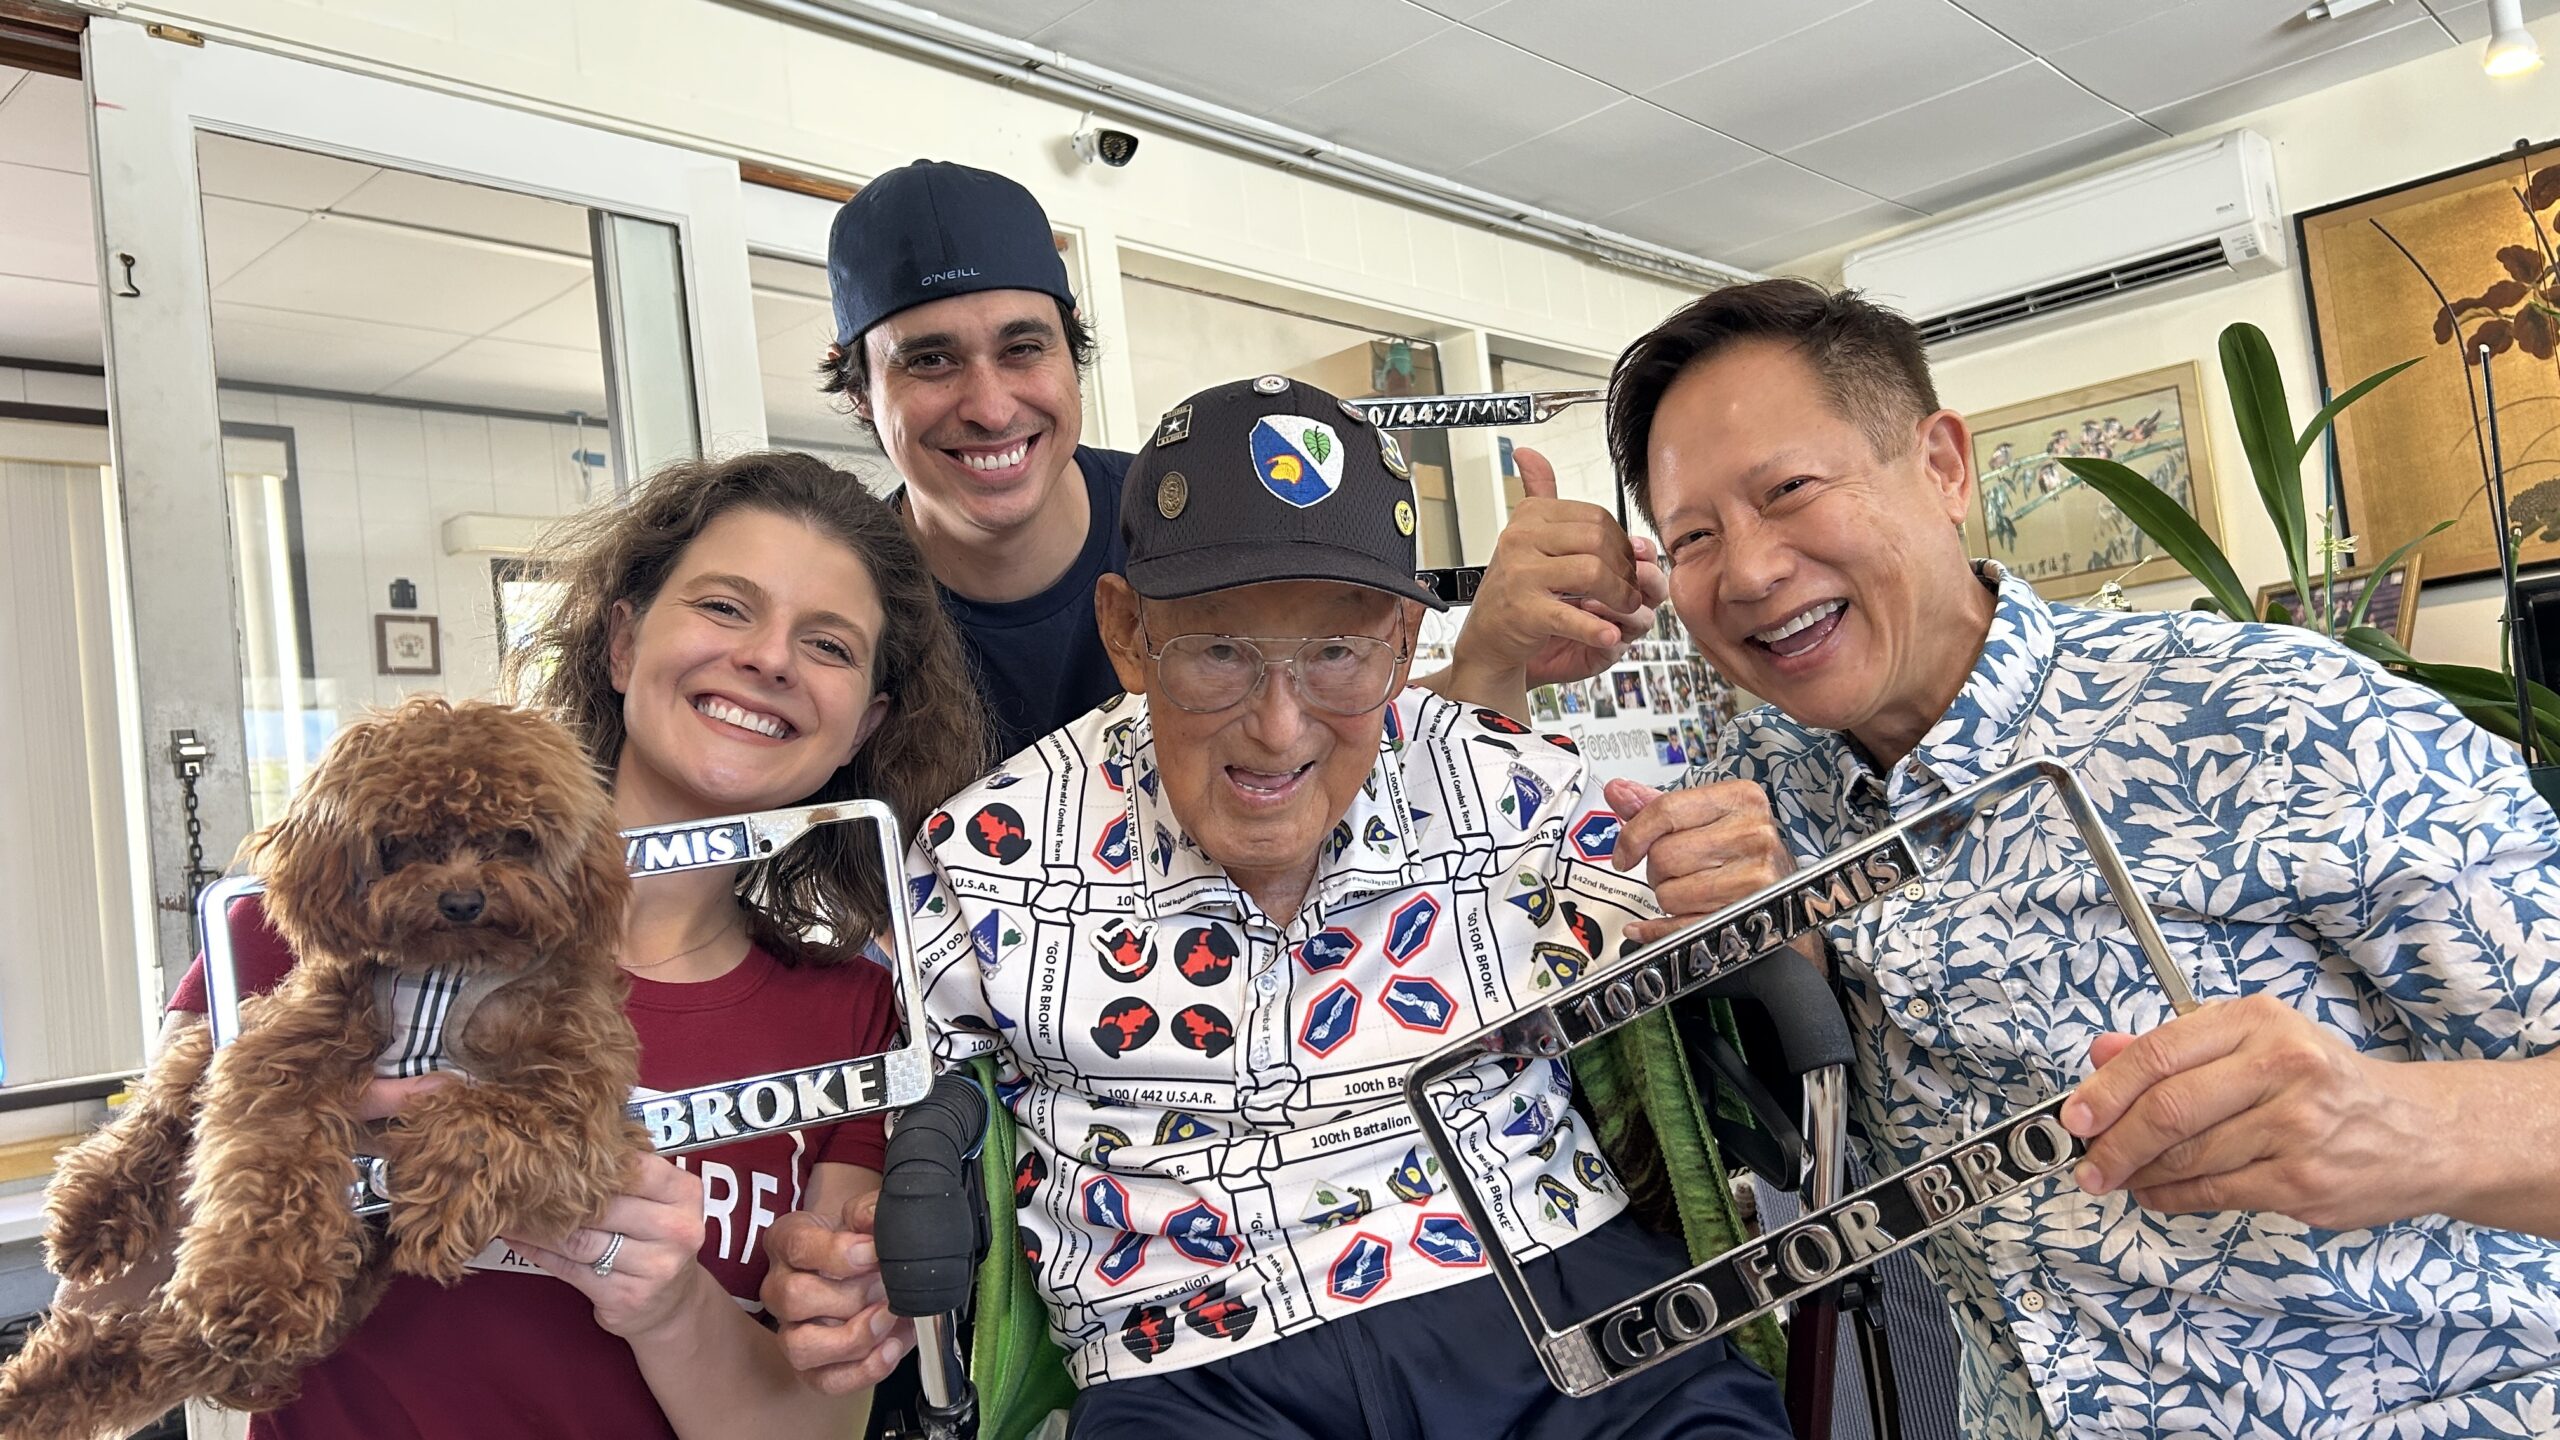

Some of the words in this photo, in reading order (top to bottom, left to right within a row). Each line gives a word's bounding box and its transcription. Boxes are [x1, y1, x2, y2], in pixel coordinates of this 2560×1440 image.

[921, 267, 981, 287] O'NEILL
[1367, 400, 1526, 427] 0/442/MIS
[1127, 785, 1135, 819] U.S.A.R.
[1389, 772, 1401, 797] 100th
[1396, 798, 1409, 834] Battalion
[1453, 779, 1467, 808] Combat
[1462, 810, 1473, 831] Team
[626, 827, 737, 870] /MIS
[1054, 839, 1063, 861] Team
[955, 877, 1000, 894] U.S.A.R.
[1572, 874, 1597, 888] 442nd
[1599, 882, 1643, 904] Regimental
[1642, 900, 1665, 915] Comb
[1469, 927, 1484, 952] FOR
[1575, 849, 1901, 1032] 100/442/MIS
[922, 948, 947, 969] FOR
[1042, 968, 1055, 992] FOR
[971, 1040, 993, 1052] 100
[1108, 1089, 1129, 1100] 100
[1141, 1090, 1163, 1102] 442
[1166, 1090, 1217, 1105] U.S.A.R.
[1344, 1077, 1385, 1095] 100th
[1388, 1075, 1404, 1090] Ba
[642, 1062, 880, 1150] BROKE
[1037, 1099, 1046, 1126] FOR
[1311, 1131, 1352, 1149] 100th
[1353, 1114, 1413, 1139] Battalion
[677, 1155, 778, 1264] RF
[1602, 1282, 1719, 1367] GO
[1733, 1200, 1898, 1309] FOR
[1904, 1114, 2074, 1226] BRO
[1284, 1296, 1295, 1319] Team
